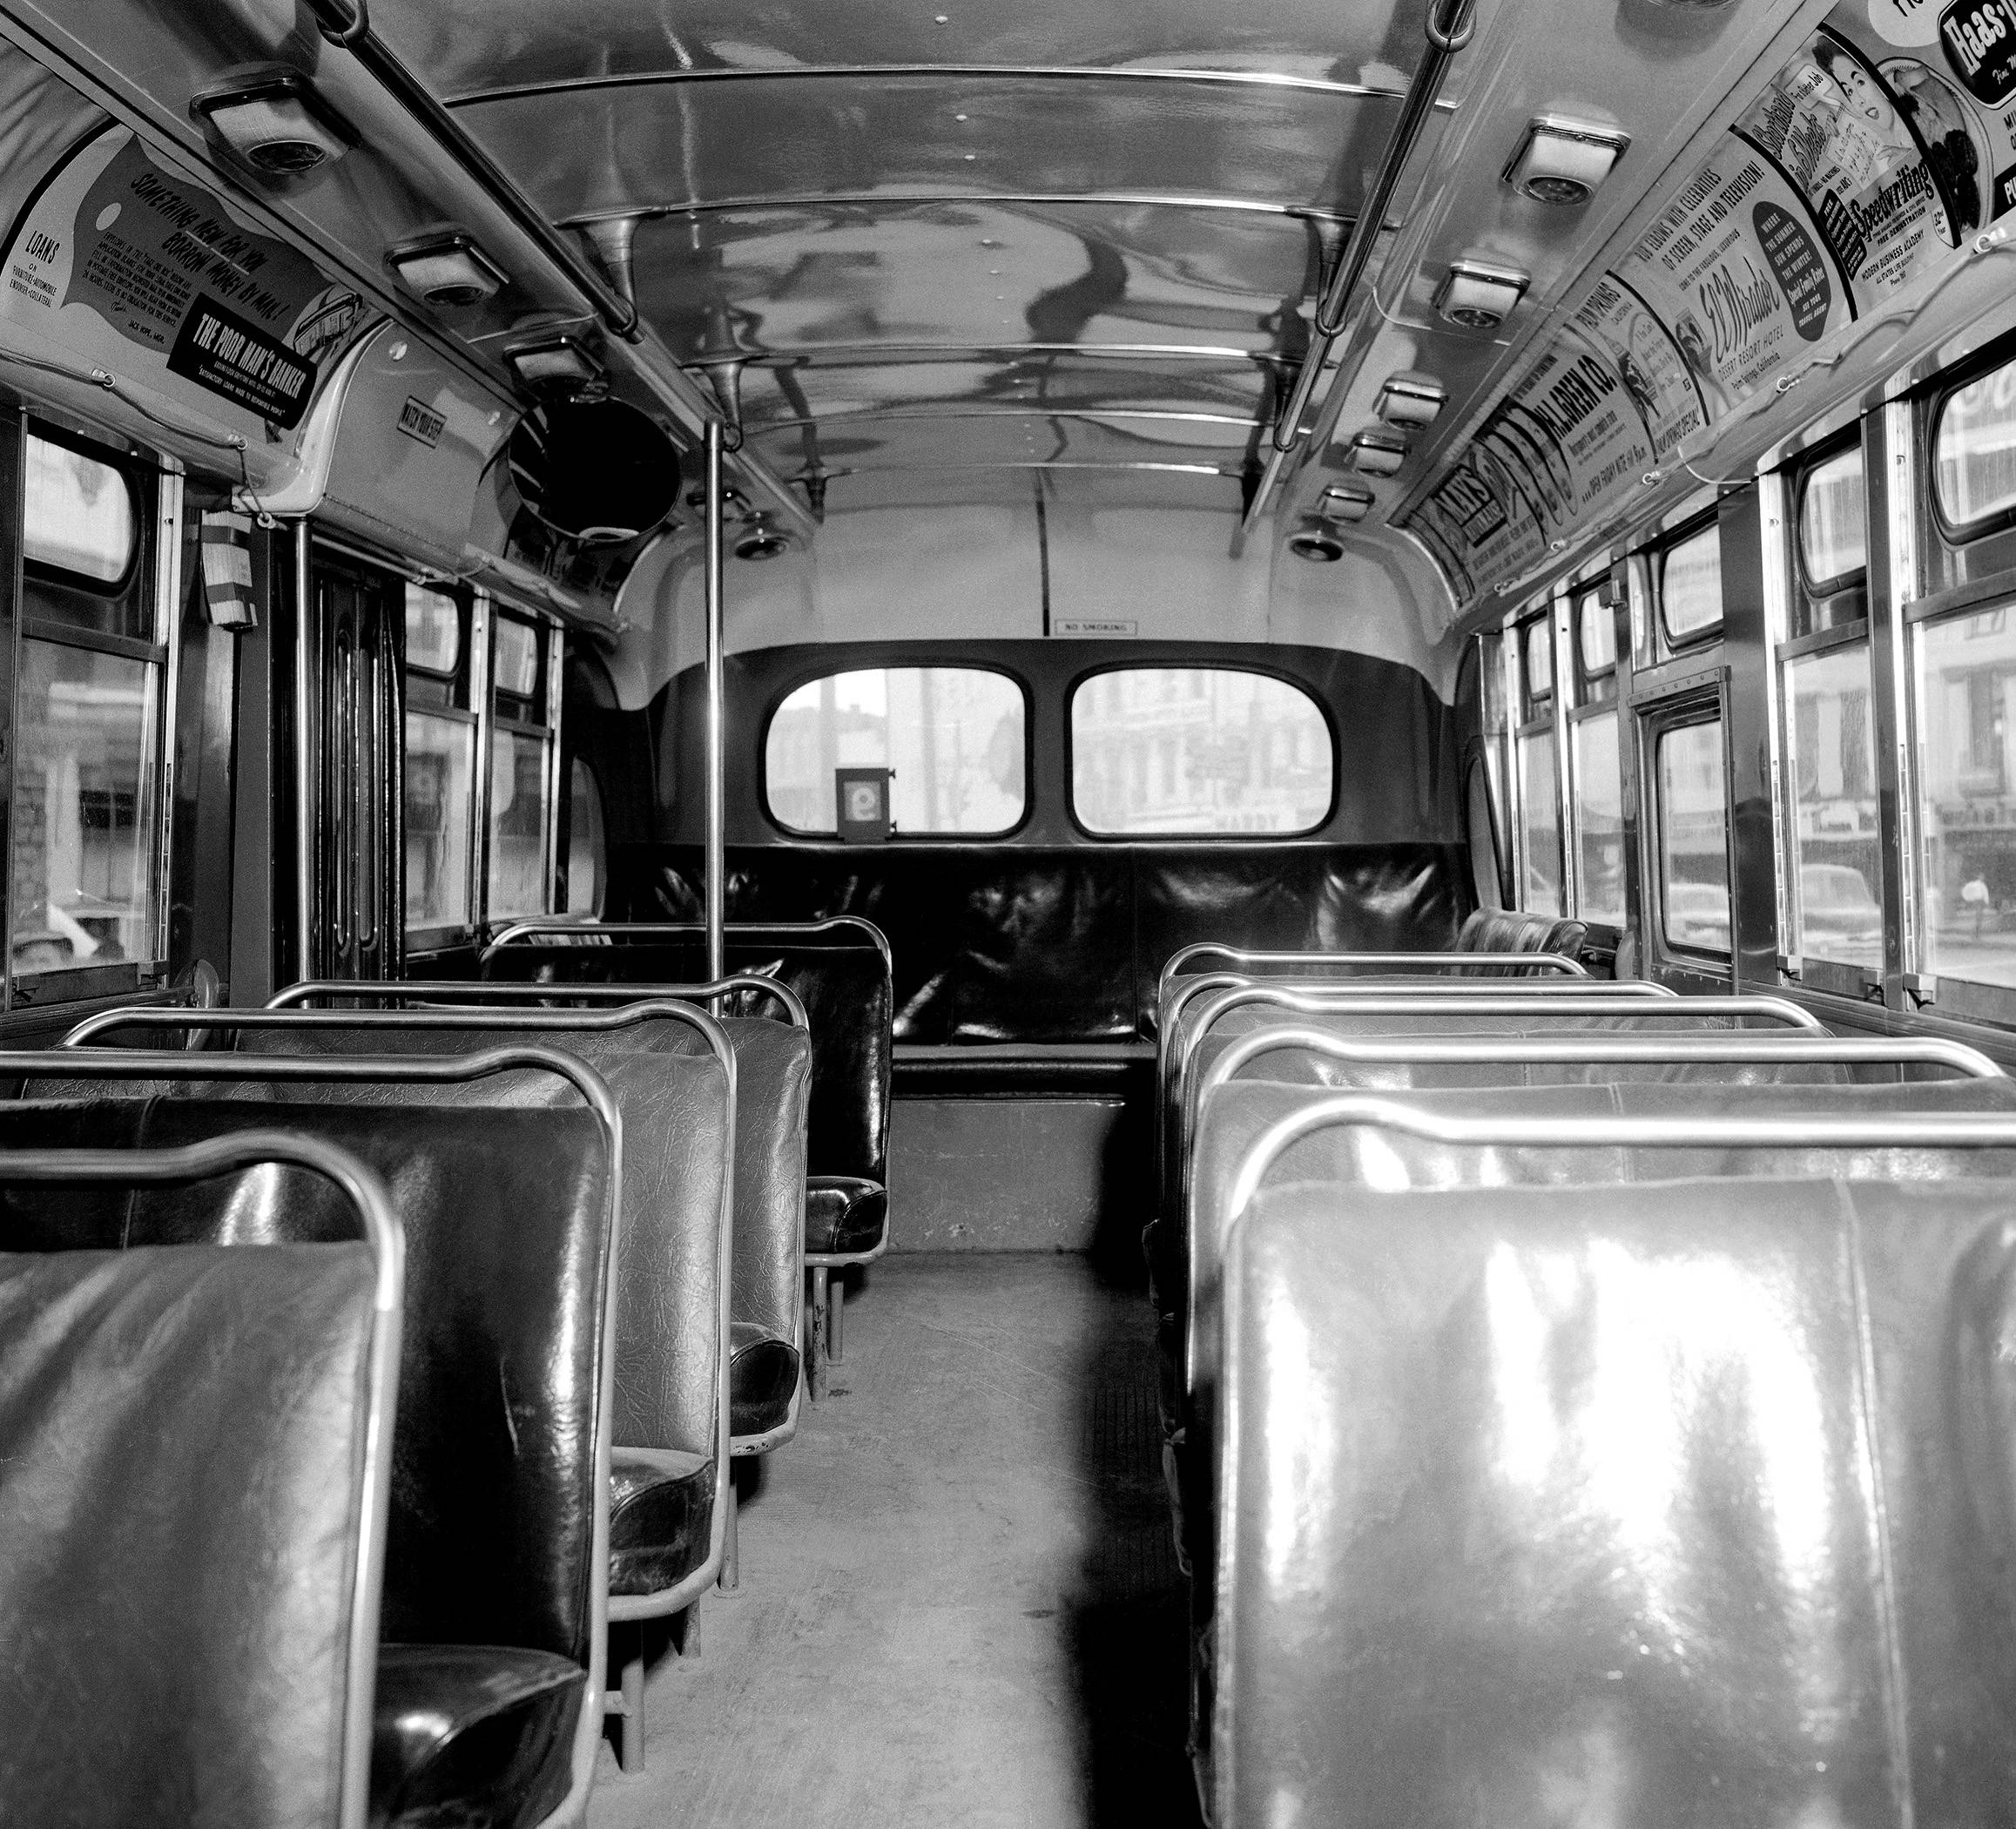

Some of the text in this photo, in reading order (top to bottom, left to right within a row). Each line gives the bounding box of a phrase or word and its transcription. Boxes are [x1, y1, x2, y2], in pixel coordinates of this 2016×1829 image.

[1943, 0, 2016, 76] Haas-
[1808, 71, 1824, 87] Job
[1752, 90, 1796, 160] Shorthand
[131, 173, 200, 228] SOMETHING
[193, 218, 229, 245] NEW
[219, 234, 250, 259] FOR
[1635, 168, 1722, 262] RUB ELBOWS WITH CELEBRITIES
[1662, 159, 1766, 271] OF SCREEN, STAGE AND TELEVISION!
[1850, 160, 1934, 242] Speedwriting
[1761, 213, 1780, 233] WHERE
[1766, 221, 1797, 253] THE SUMMER
[1878, 235, 1889, 246] FREE
[1890, 206, 1926, 236] DEMONSTRATION
[25, 230, 60, 264] LOANS
[1693, 265, 1702, 277] THE
[1718, 228, 1741, 253] LUXURIOUS
[1774, 235, 1804, 267] SUN SPENDS
[1782, 250, 1812, 280] THE WINTER!
[1862, 262, 1879, 281] MODERN
[1880, 246, 1904, 268] BUSINESS
[1904, 229, 1924, 253] ACADEMY
[29, 263, 37, 273] ON
[161, 232, 216, 273] BORROW
[205, 260, 246, 298] MONEY
[238, 282, 260, 304] BY
[1810, 267, 1825, 285] Rates
[1882, 268, 1894, 280] STATES
[1810, 293, 1822, 307] YOUR
[1814, 303, 1827, 320] AGENT
[193, 314, 221, 350] THE
[213, 325, 246, 364] POOR
[238, 341, 276, 380] MAN'S
[267, 358, 307, 399] BANKER
[1718, 324, 1783, 382] DESERT RESORT HOTEL
[1731, 375, 1743, 390] Palm
[1757, 351, 1780, 373] California
[1577, 354, 1618, 395] CO.
